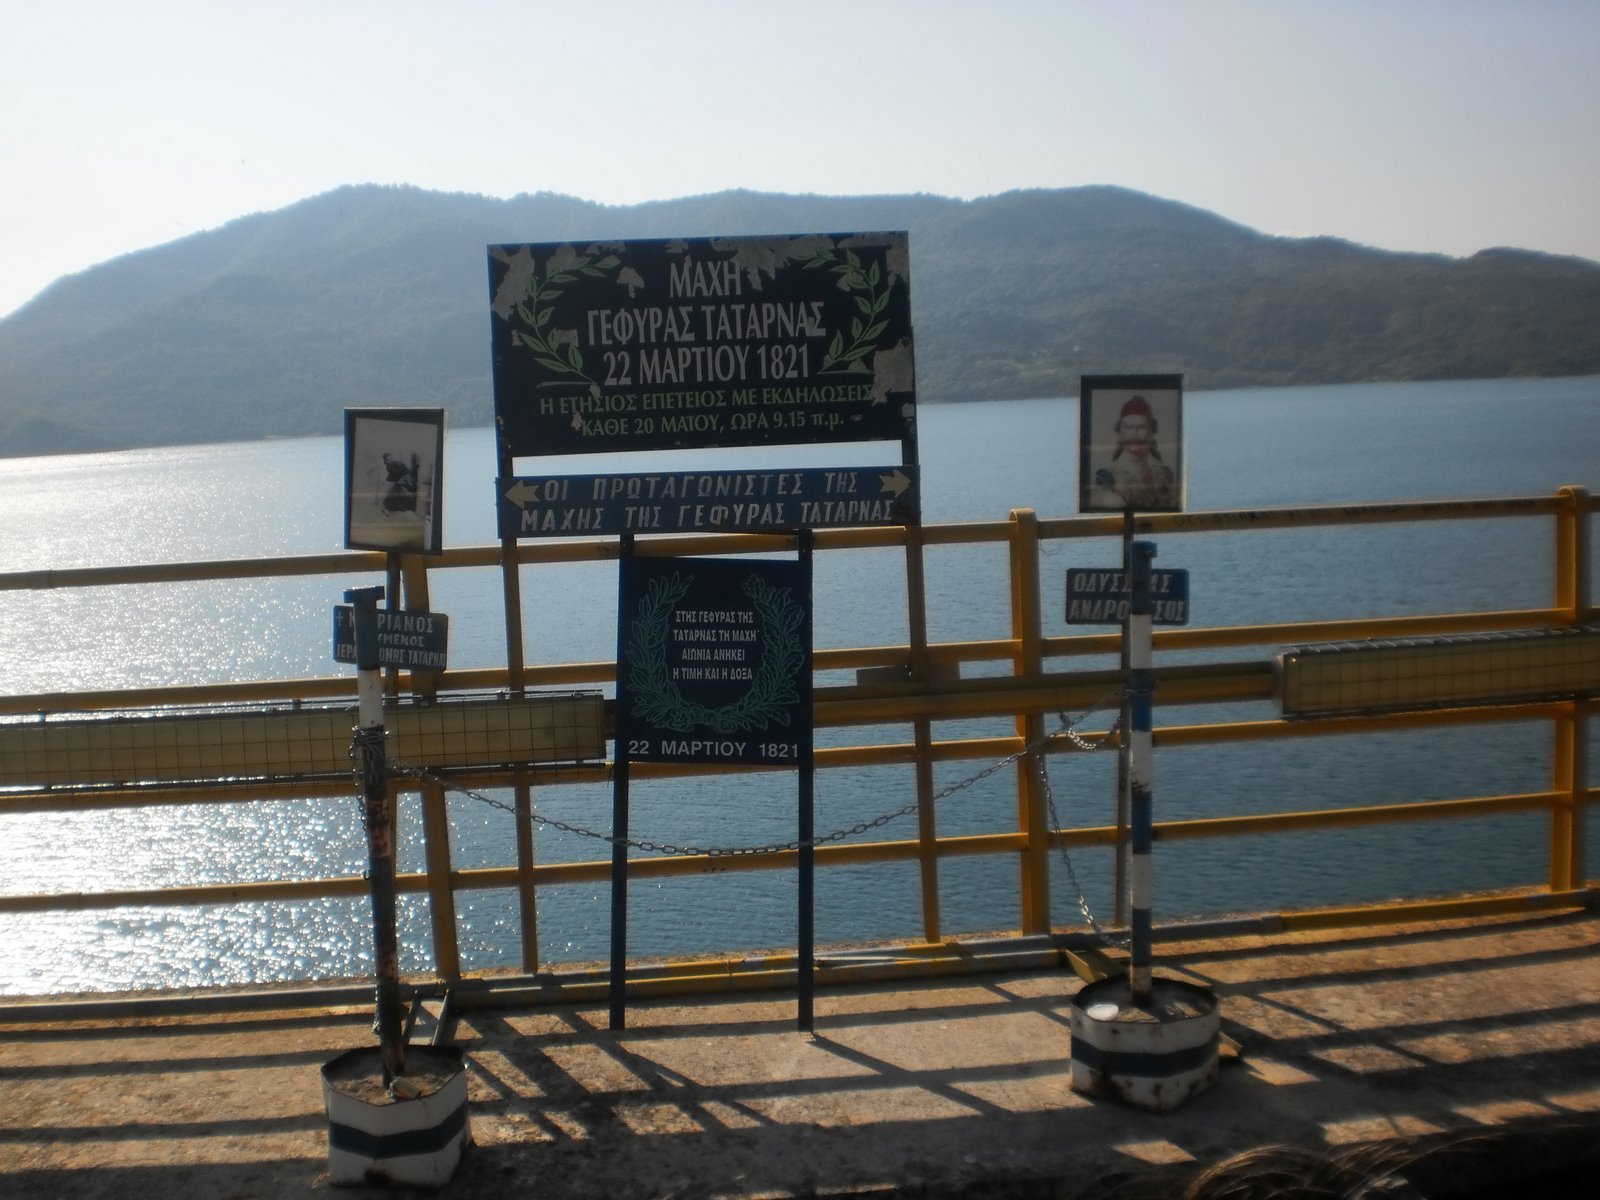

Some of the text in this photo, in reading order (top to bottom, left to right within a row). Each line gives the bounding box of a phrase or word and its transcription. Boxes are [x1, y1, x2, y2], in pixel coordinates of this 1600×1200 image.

[669, 261, 742, 298] ΜΑΧΗ
[587, 302, 827, 346] ΓΕΦΥΡΑΣ ΤΑΤΑΡΝΑΣ
[603, 343, 809, 386] 22 ΜΑΡΤΙΟΥ 1821
[540, 384, 873, 415] Η ΕΤΗΣΙΟΣ ΕΠΕΤΕΙΟΣ ΜΕ ΕΚΔΗΛΩΣΕΙΣ
[582, 418, 630, 437] ΚΑΘΕ
[634, 417, 655, 435] 20
[731, 414, 769, 430] ΩΡΑ
[773, 411, 806, 428] 9.15
[812, 412, 845, 432] π.μ.
[544, 472, 859, 501] ΟΙ ΠΡΩΤΑΓΩΝΙΣΤΕΣ ΤΗΣ
[521, 500, 894, 532] ΜΑΧΗΣ ΤΗΣ ΓΕΦΥΡΑΣ ΤΑΤΑΡΝΑΣ
[675, 611, 754, 624] ΣΤΗΣ ΓΕΦΥΡΑΣ ΤΗΣ
[1069, 599, 1186, 621] ΑΝΔΡΟΣΟΣ
[348, 611, 433, 634] ΚΡΙΑΝΟΣ
[673, 630, 717, 642] ΤΑΤΑΡΝΑΣ
[719, 630, 730, 642] ΤΗ
[681, 648, 745, 661] ΑΙΩΝΙΑ ΑΝΗΚΕΙ
[672, 667, 753, 680] Η ΤΙΜΗ ΚΑΙ Η ΔΟΞΑ
[628, 740, 799, 758] 22 ΜΑΡΤΙΟΥ 1821
